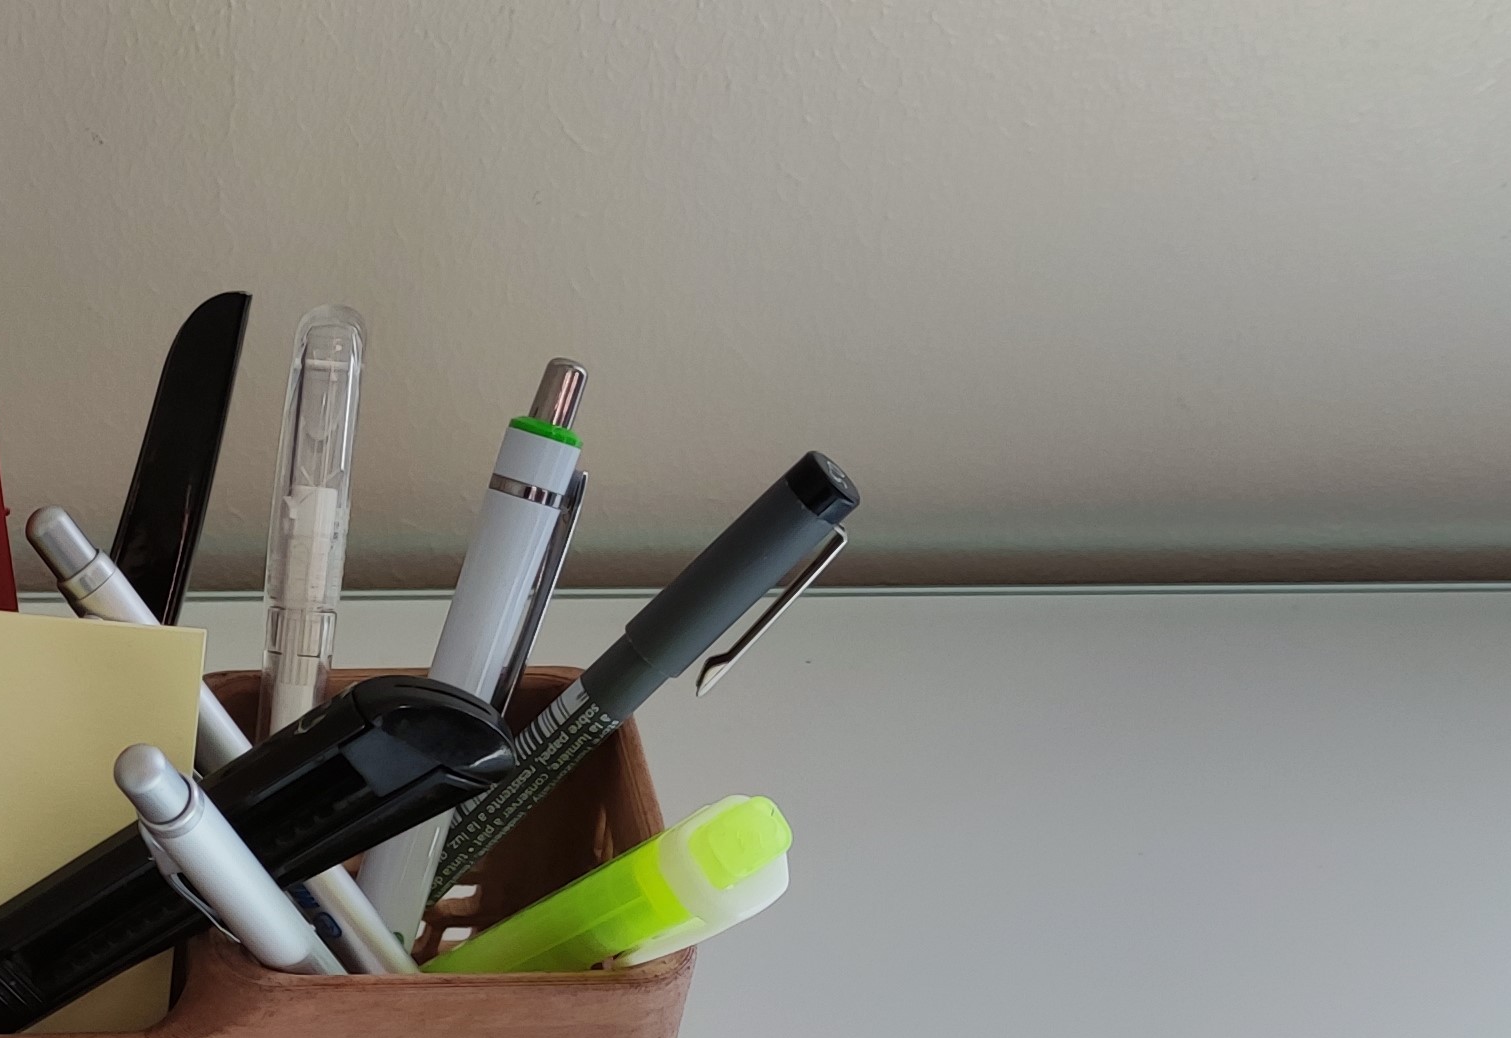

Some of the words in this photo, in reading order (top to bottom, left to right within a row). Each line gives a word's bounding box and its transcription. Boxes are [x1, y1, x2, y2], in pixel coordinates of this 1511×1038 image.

[566, 702, 601, 737] sobre
[587, 720, 603, 736] la
[532, 730, 571, 768] papel,
[484, 763, 538, 815] resistente
[500, 771, 550, 819] conserver
[465, 819, 481, 835] la
[476, 811, 488, 822] a
[471, 823, 496, 848] plat
[440, 850, 469, 878] tinta
